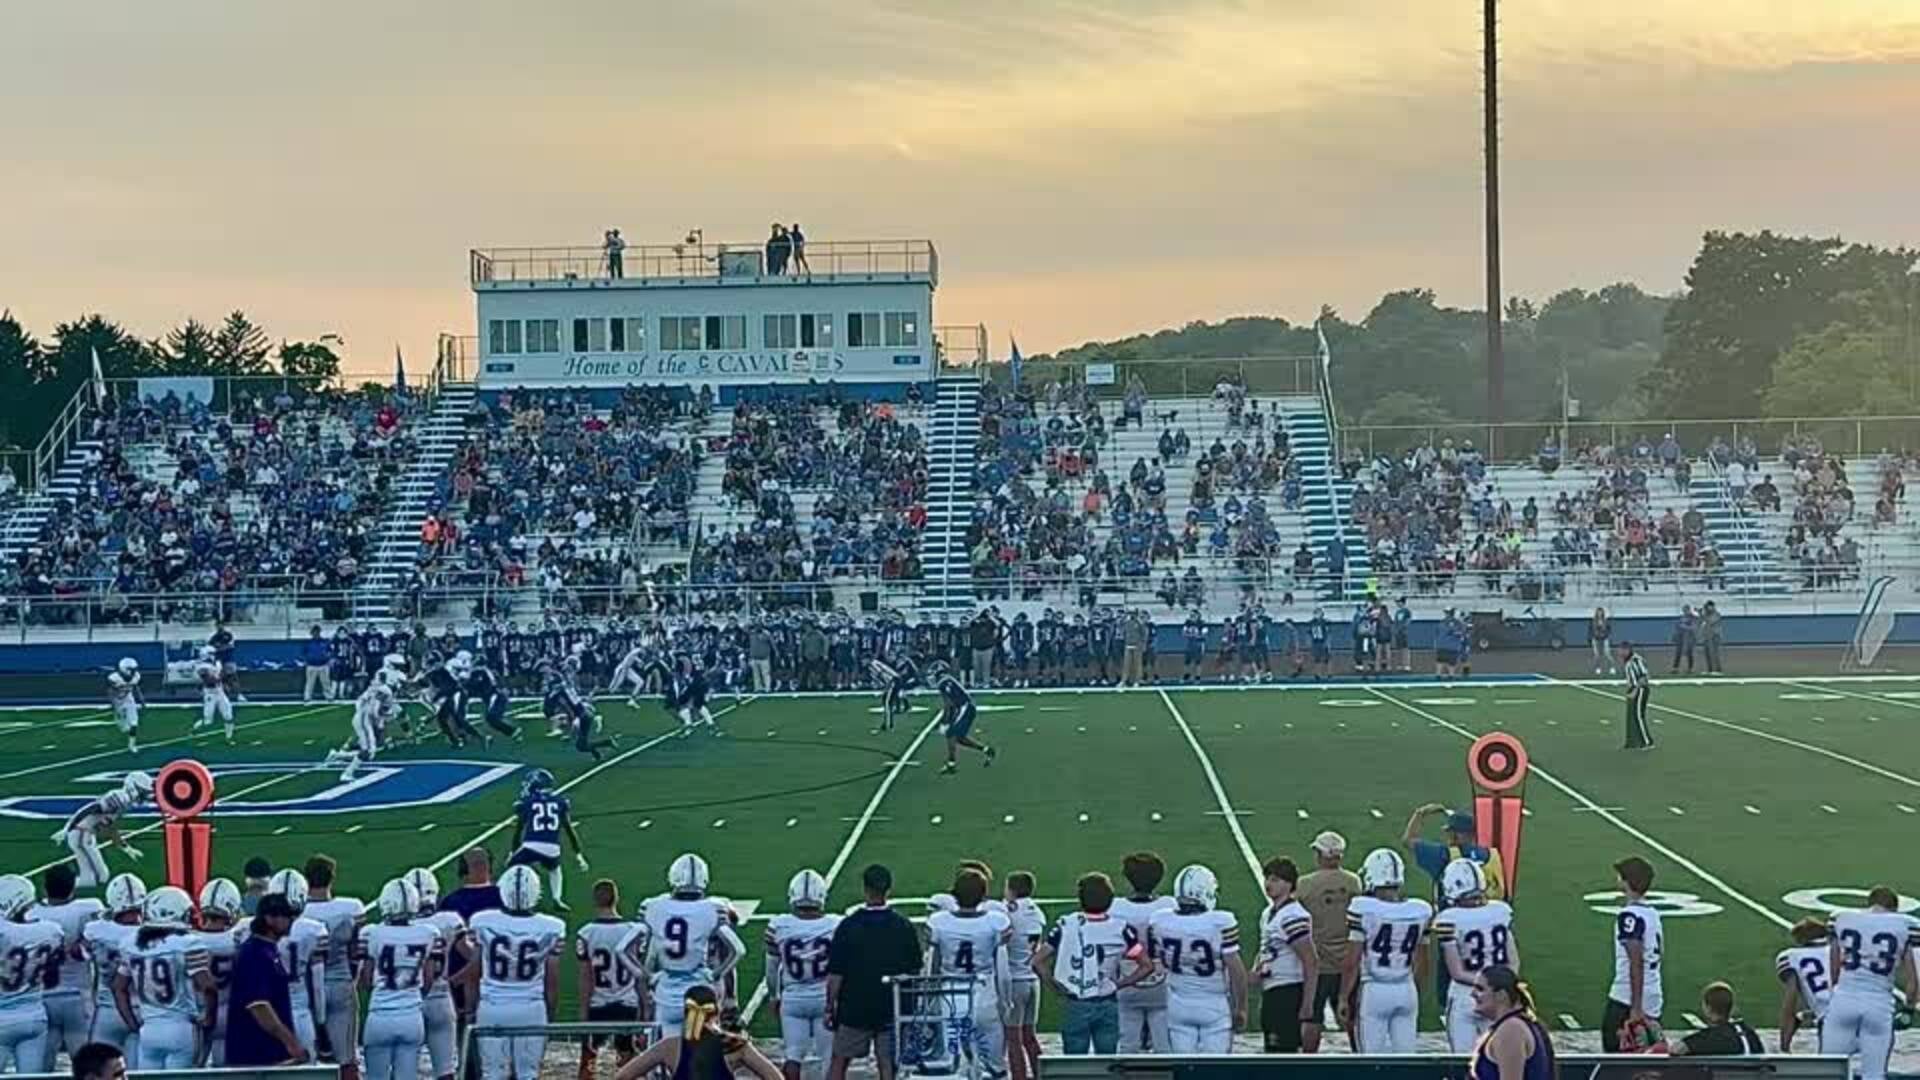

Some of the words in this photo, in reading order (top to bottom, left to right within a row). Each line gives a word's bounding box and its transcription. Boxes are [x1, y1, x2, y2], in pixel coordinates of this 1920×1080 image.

[563, 355, 621, 376] Home
[627, 354, 650, 376] of
[657, 354, 687, 374] the
[717, 353, 845, 374] CAVALS
[532, 802, 559, 832] 25
[664, 916, 689, 960] 9
[1371, 923, 1420, 968] 44
[1623, 915, 1636, 933] 9
[377, 944, 427, 990] 47
[489, 934, 539, 981] 66
[953, 939, 976, 974] 4
[1161, 937, 1216, 977] 73
[1464, 924, 1508, 971] 38
[1841, 927, 1899, 976] 33
[128, 956, 176, 1006] 79
